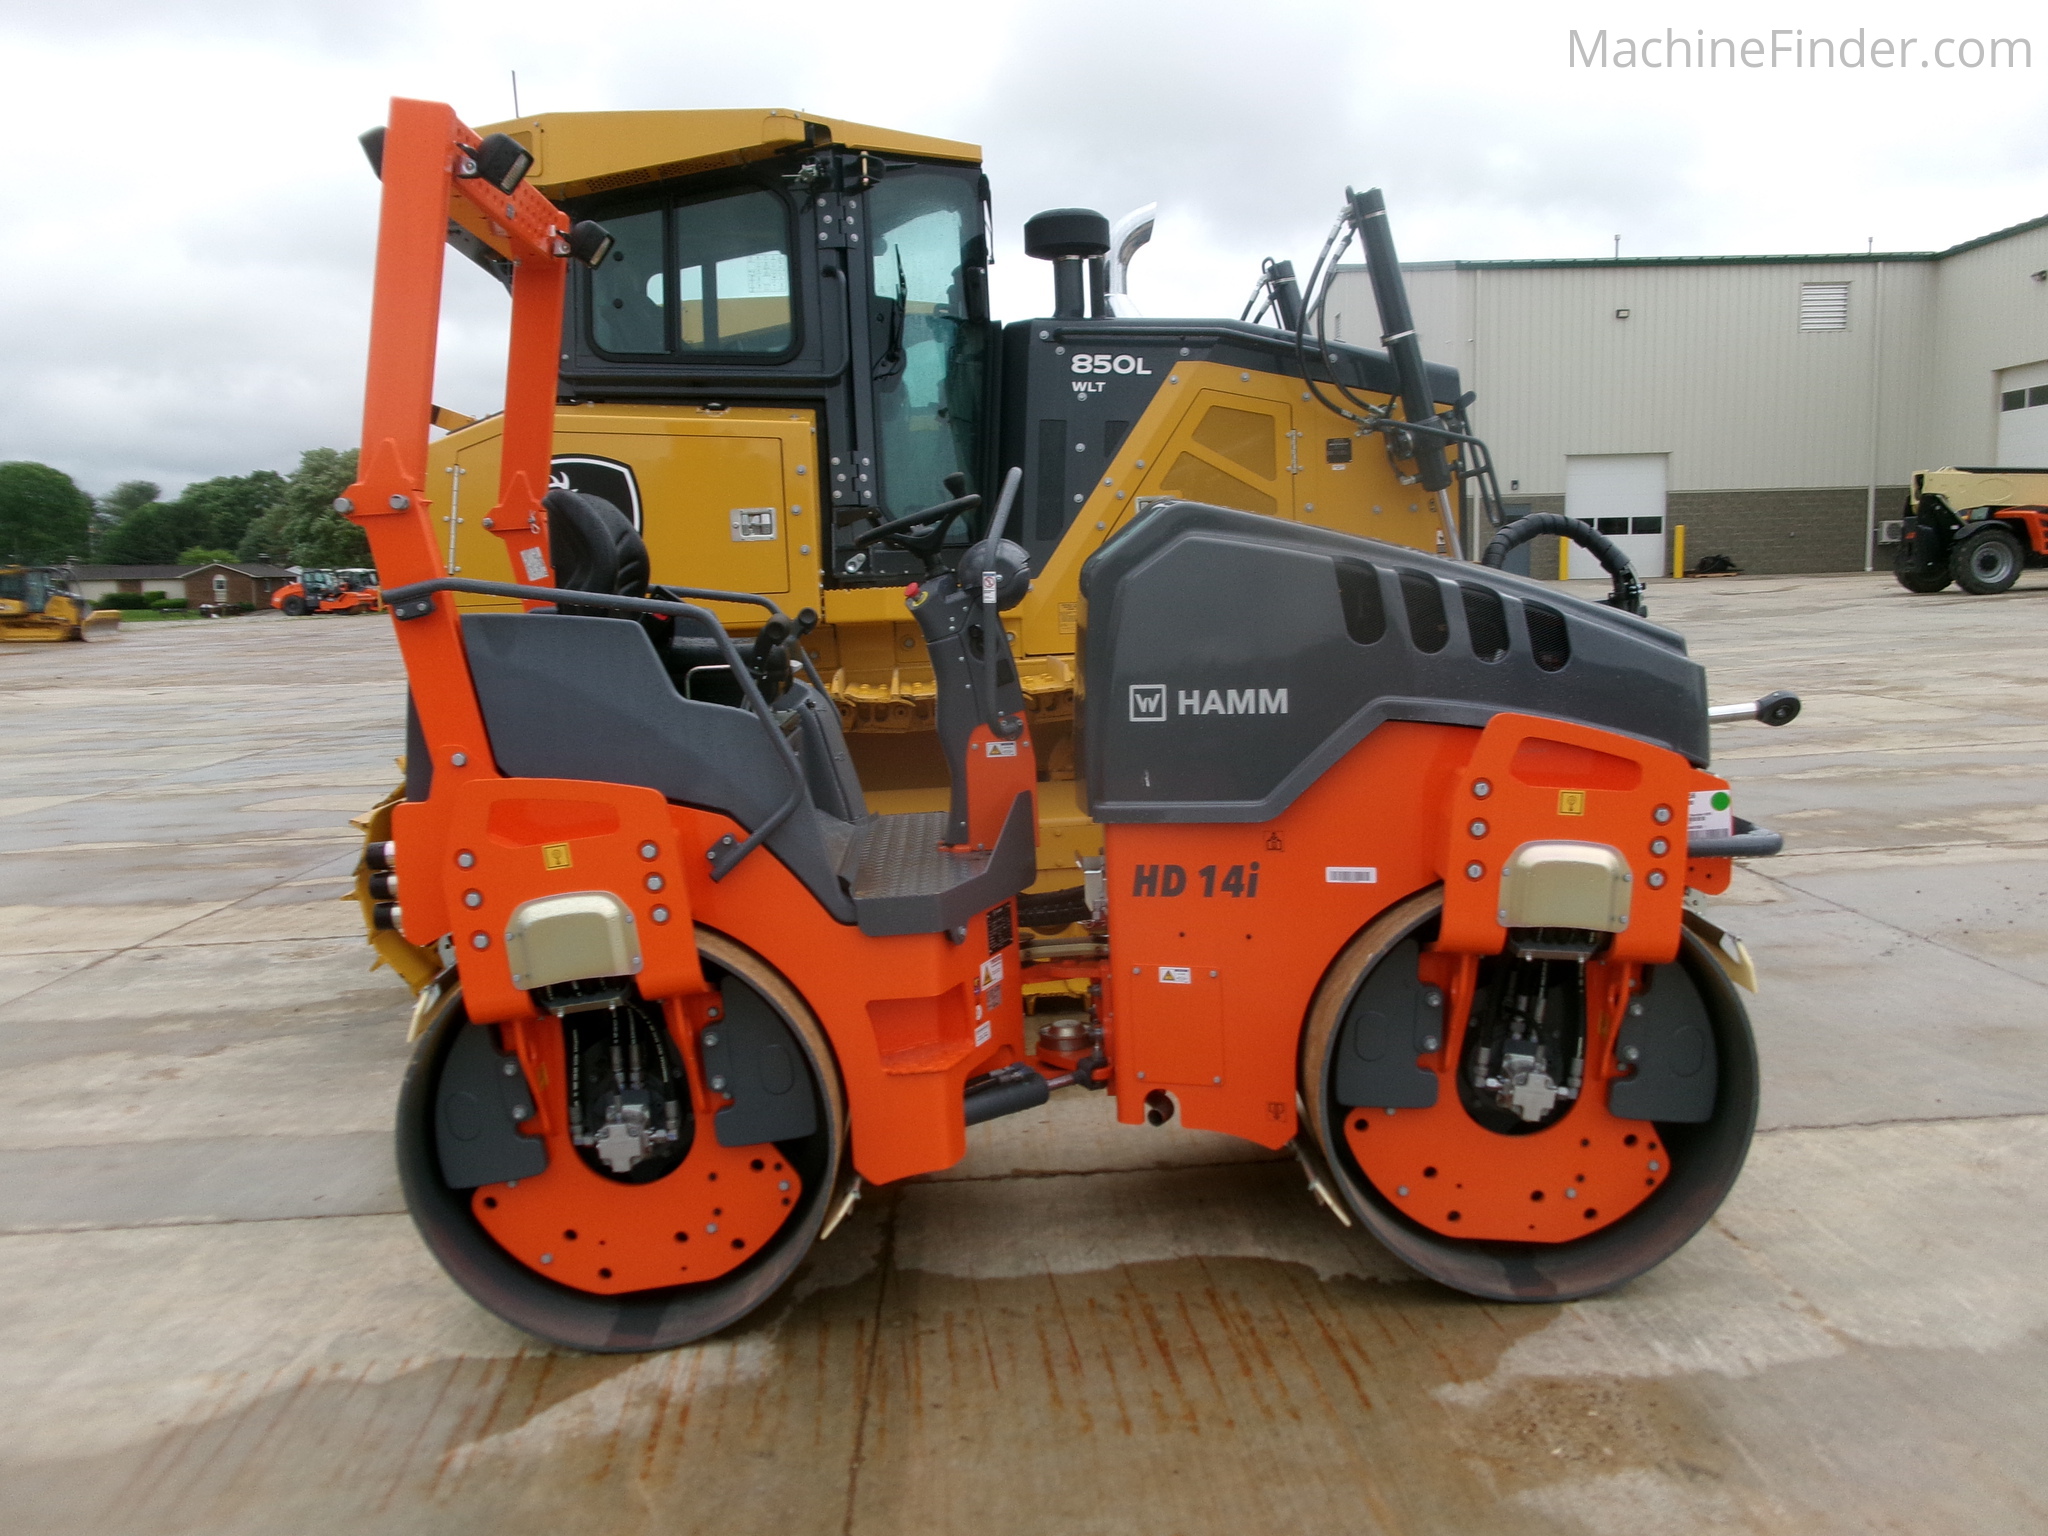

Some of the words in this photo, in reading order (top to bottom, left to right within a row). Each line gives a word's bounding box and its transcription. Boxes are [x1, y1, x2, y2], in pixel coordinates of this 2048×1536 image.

[1071, 353, 1152, 375] 850L
[1071, 381, 1106, 393] WLT
[1178, 688, 1289, 715] HAMM
[1132, 864, 1187, 897] HD
[1198, 861, 1260, 897] 14i
